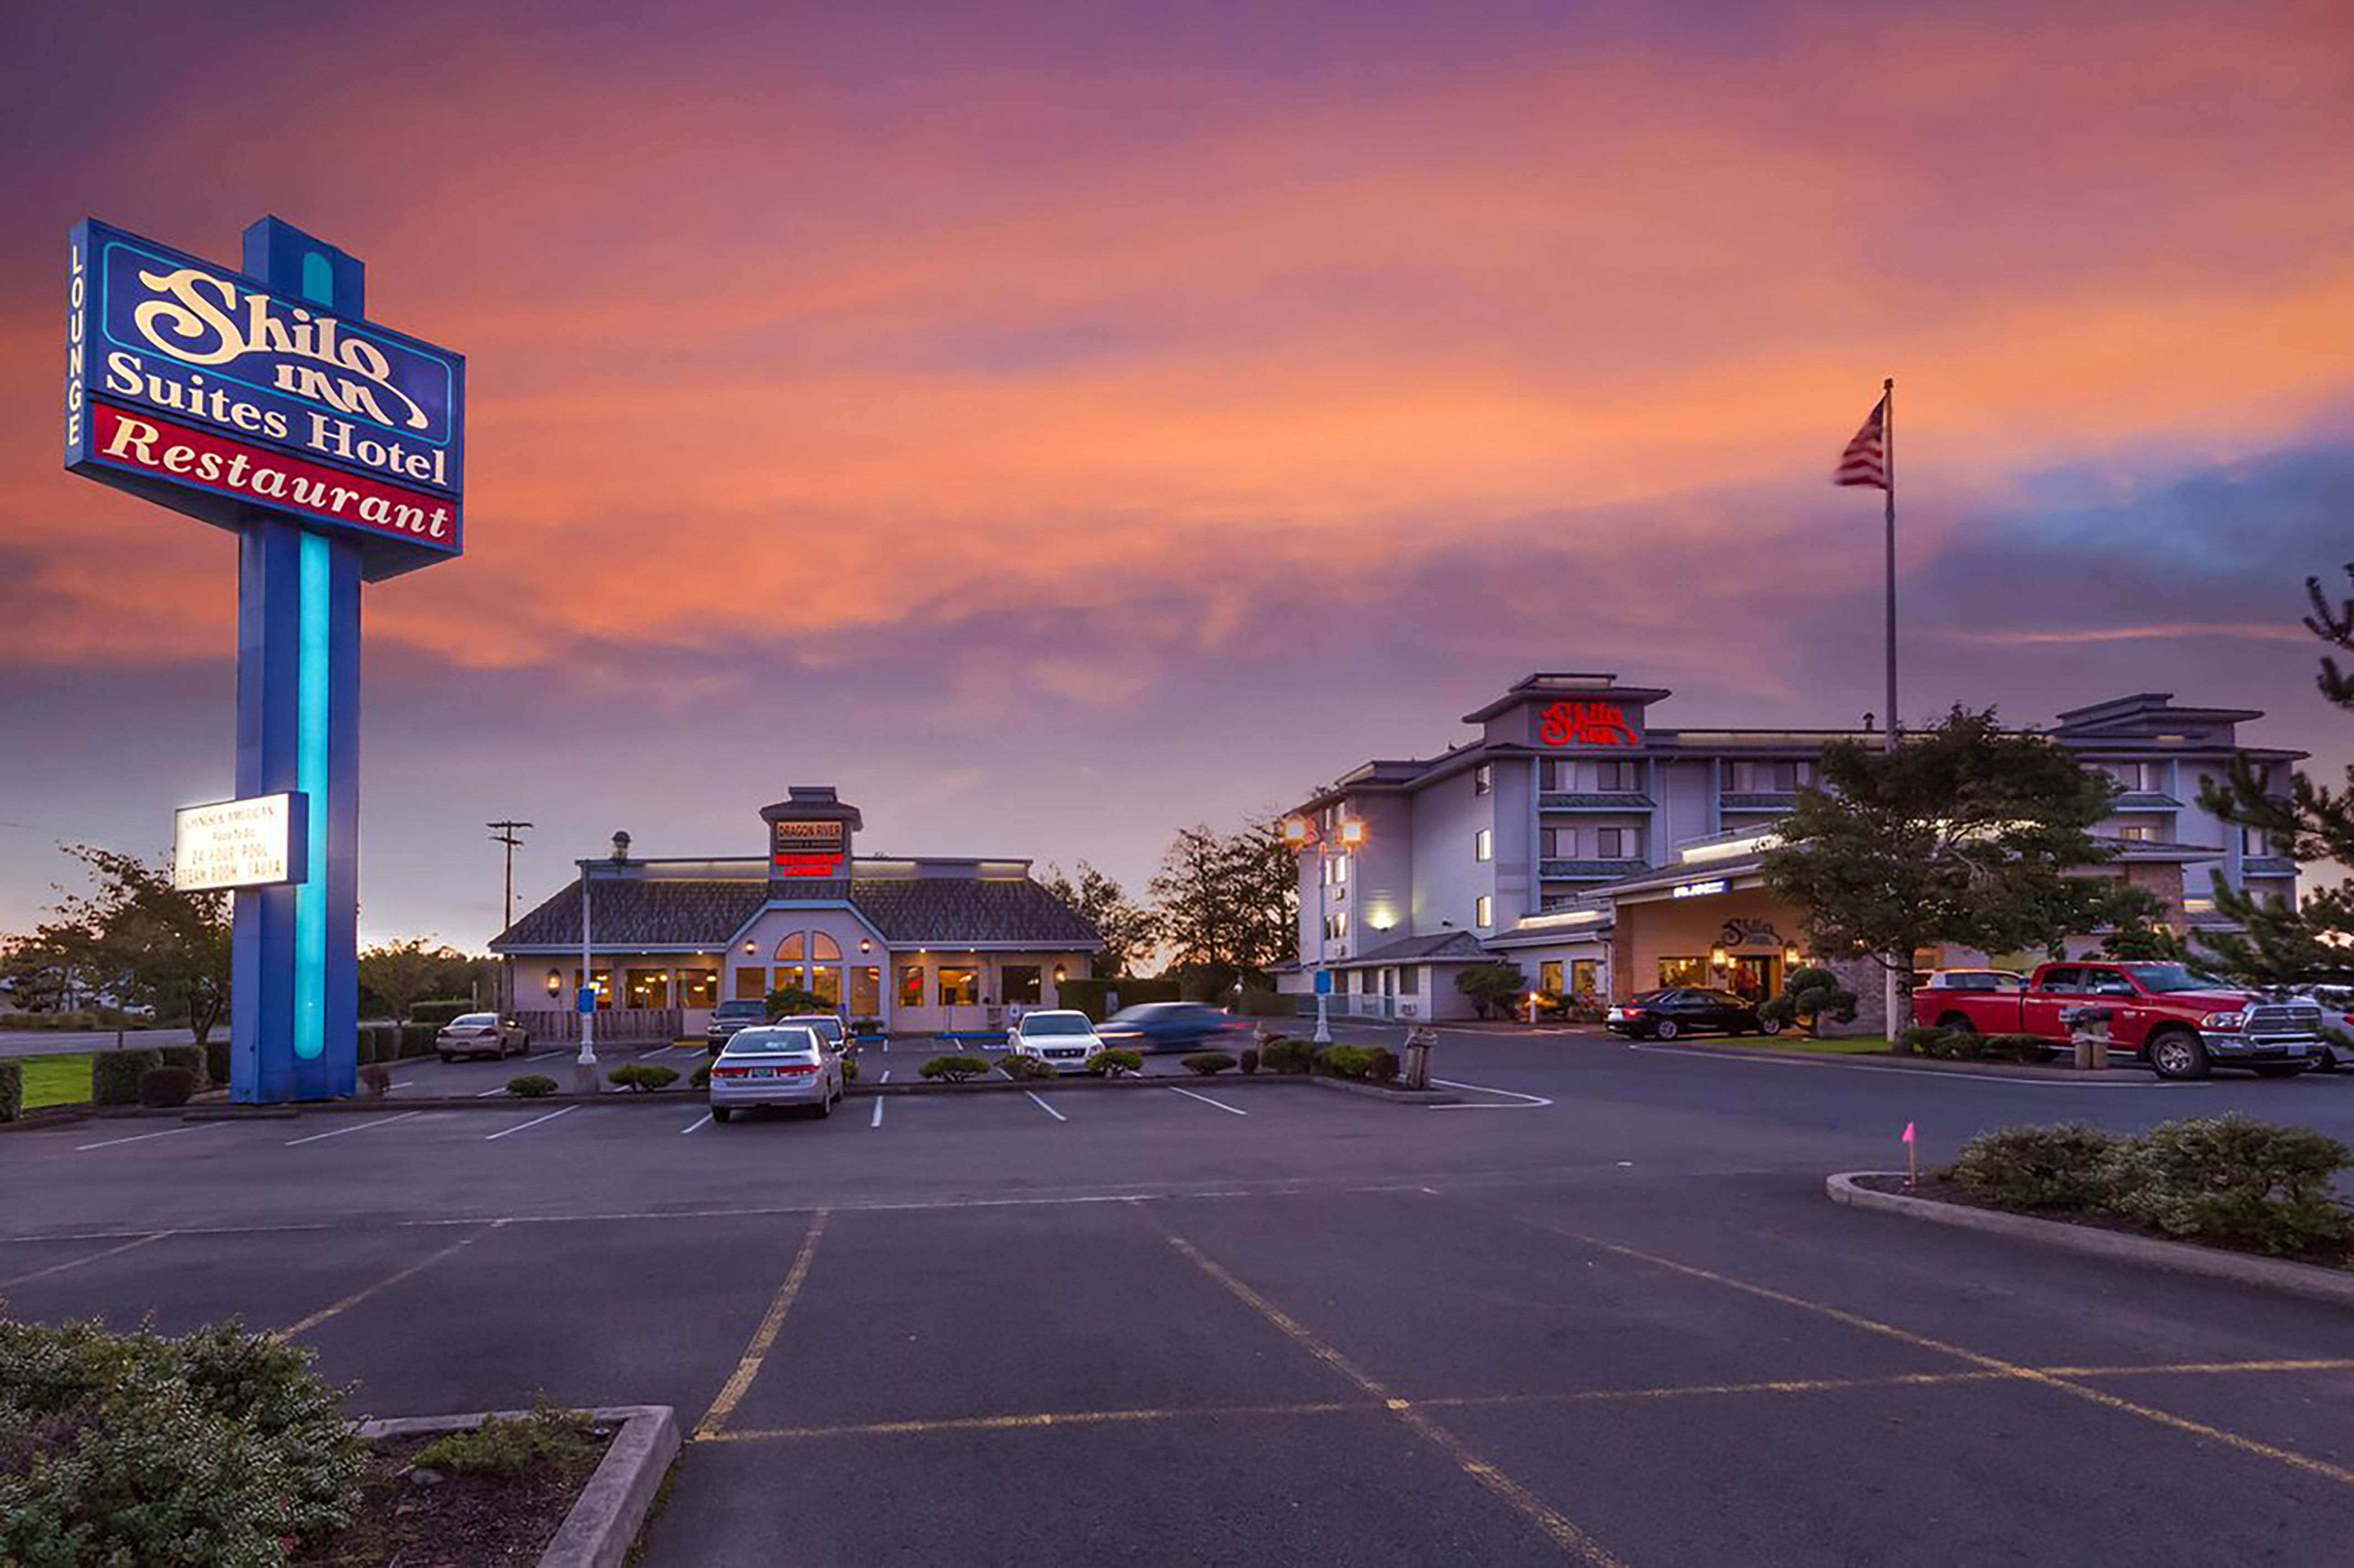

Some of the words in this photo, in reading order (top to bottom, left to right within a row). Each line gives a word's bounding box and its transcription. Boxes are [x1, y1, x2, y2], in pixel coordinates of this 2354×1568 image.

[69, 246, 83, 446] LOUNGE
[134, 269, 429, 429] Shilo
[102, 415, 449, 538] Restaurant
[106, 352, 288, 439] Suites
[306, 411, 448, 486] Hotel
[779, 825, 814, 837] DRAGON
[816, 824, 840, 837] RIVER
